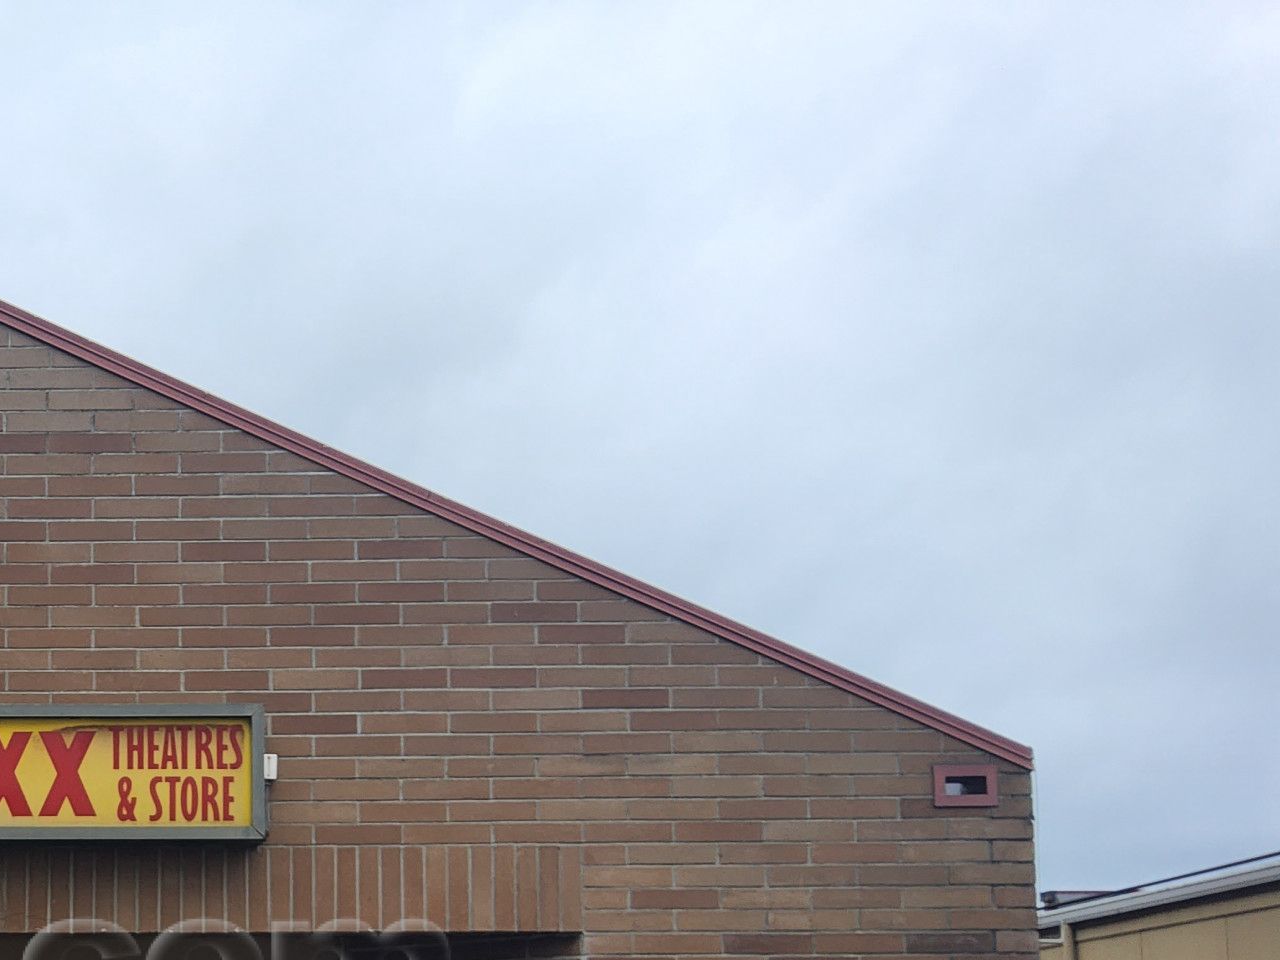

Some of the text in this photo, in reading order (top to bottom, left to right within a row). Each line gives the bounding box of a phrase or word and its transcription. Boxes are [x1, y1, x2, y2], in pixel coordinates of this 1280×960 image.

[108, 724, 245, 770] THEATRES
[117, 776, 235, 822] & STORE
